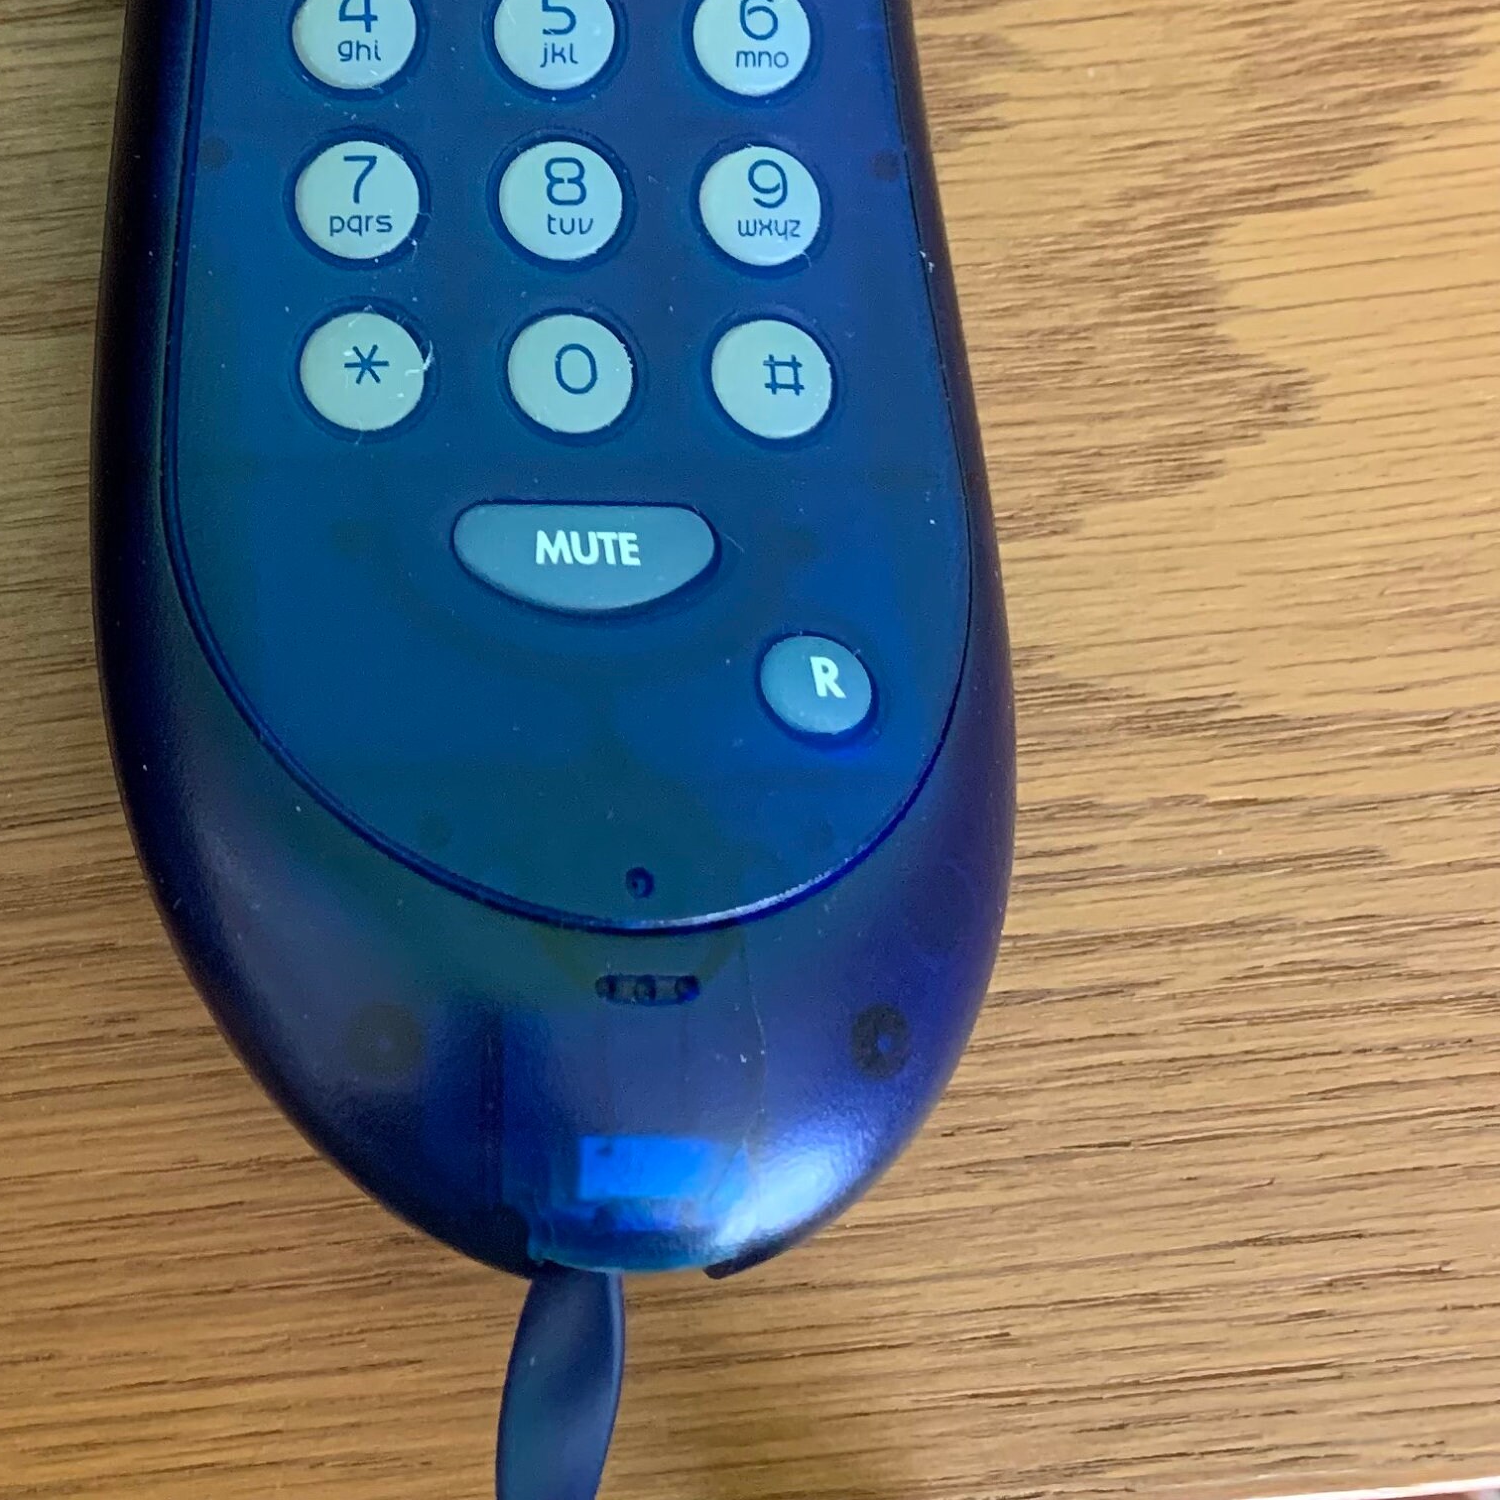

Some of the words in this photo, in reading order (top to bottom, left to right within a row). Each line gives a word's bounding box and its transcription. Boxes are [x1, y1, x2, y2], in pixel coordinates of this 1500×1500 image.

[337, 37, 382, 64] ghi
[538, 41, 579, 69] jkl
[735, 50, 790, 70] mno
[342, 156, 379, 204] 7
[544, 157, 586, 206] 8
[747, 159, 788, 208] 9
[328, 210, 393, 238] pqrs
[547, 212, 594, 235] tuv
[736, 216, 802, 240] wxyz
[535, 530, 641, 567] MUTE
[810, 656, 846, 698] R
